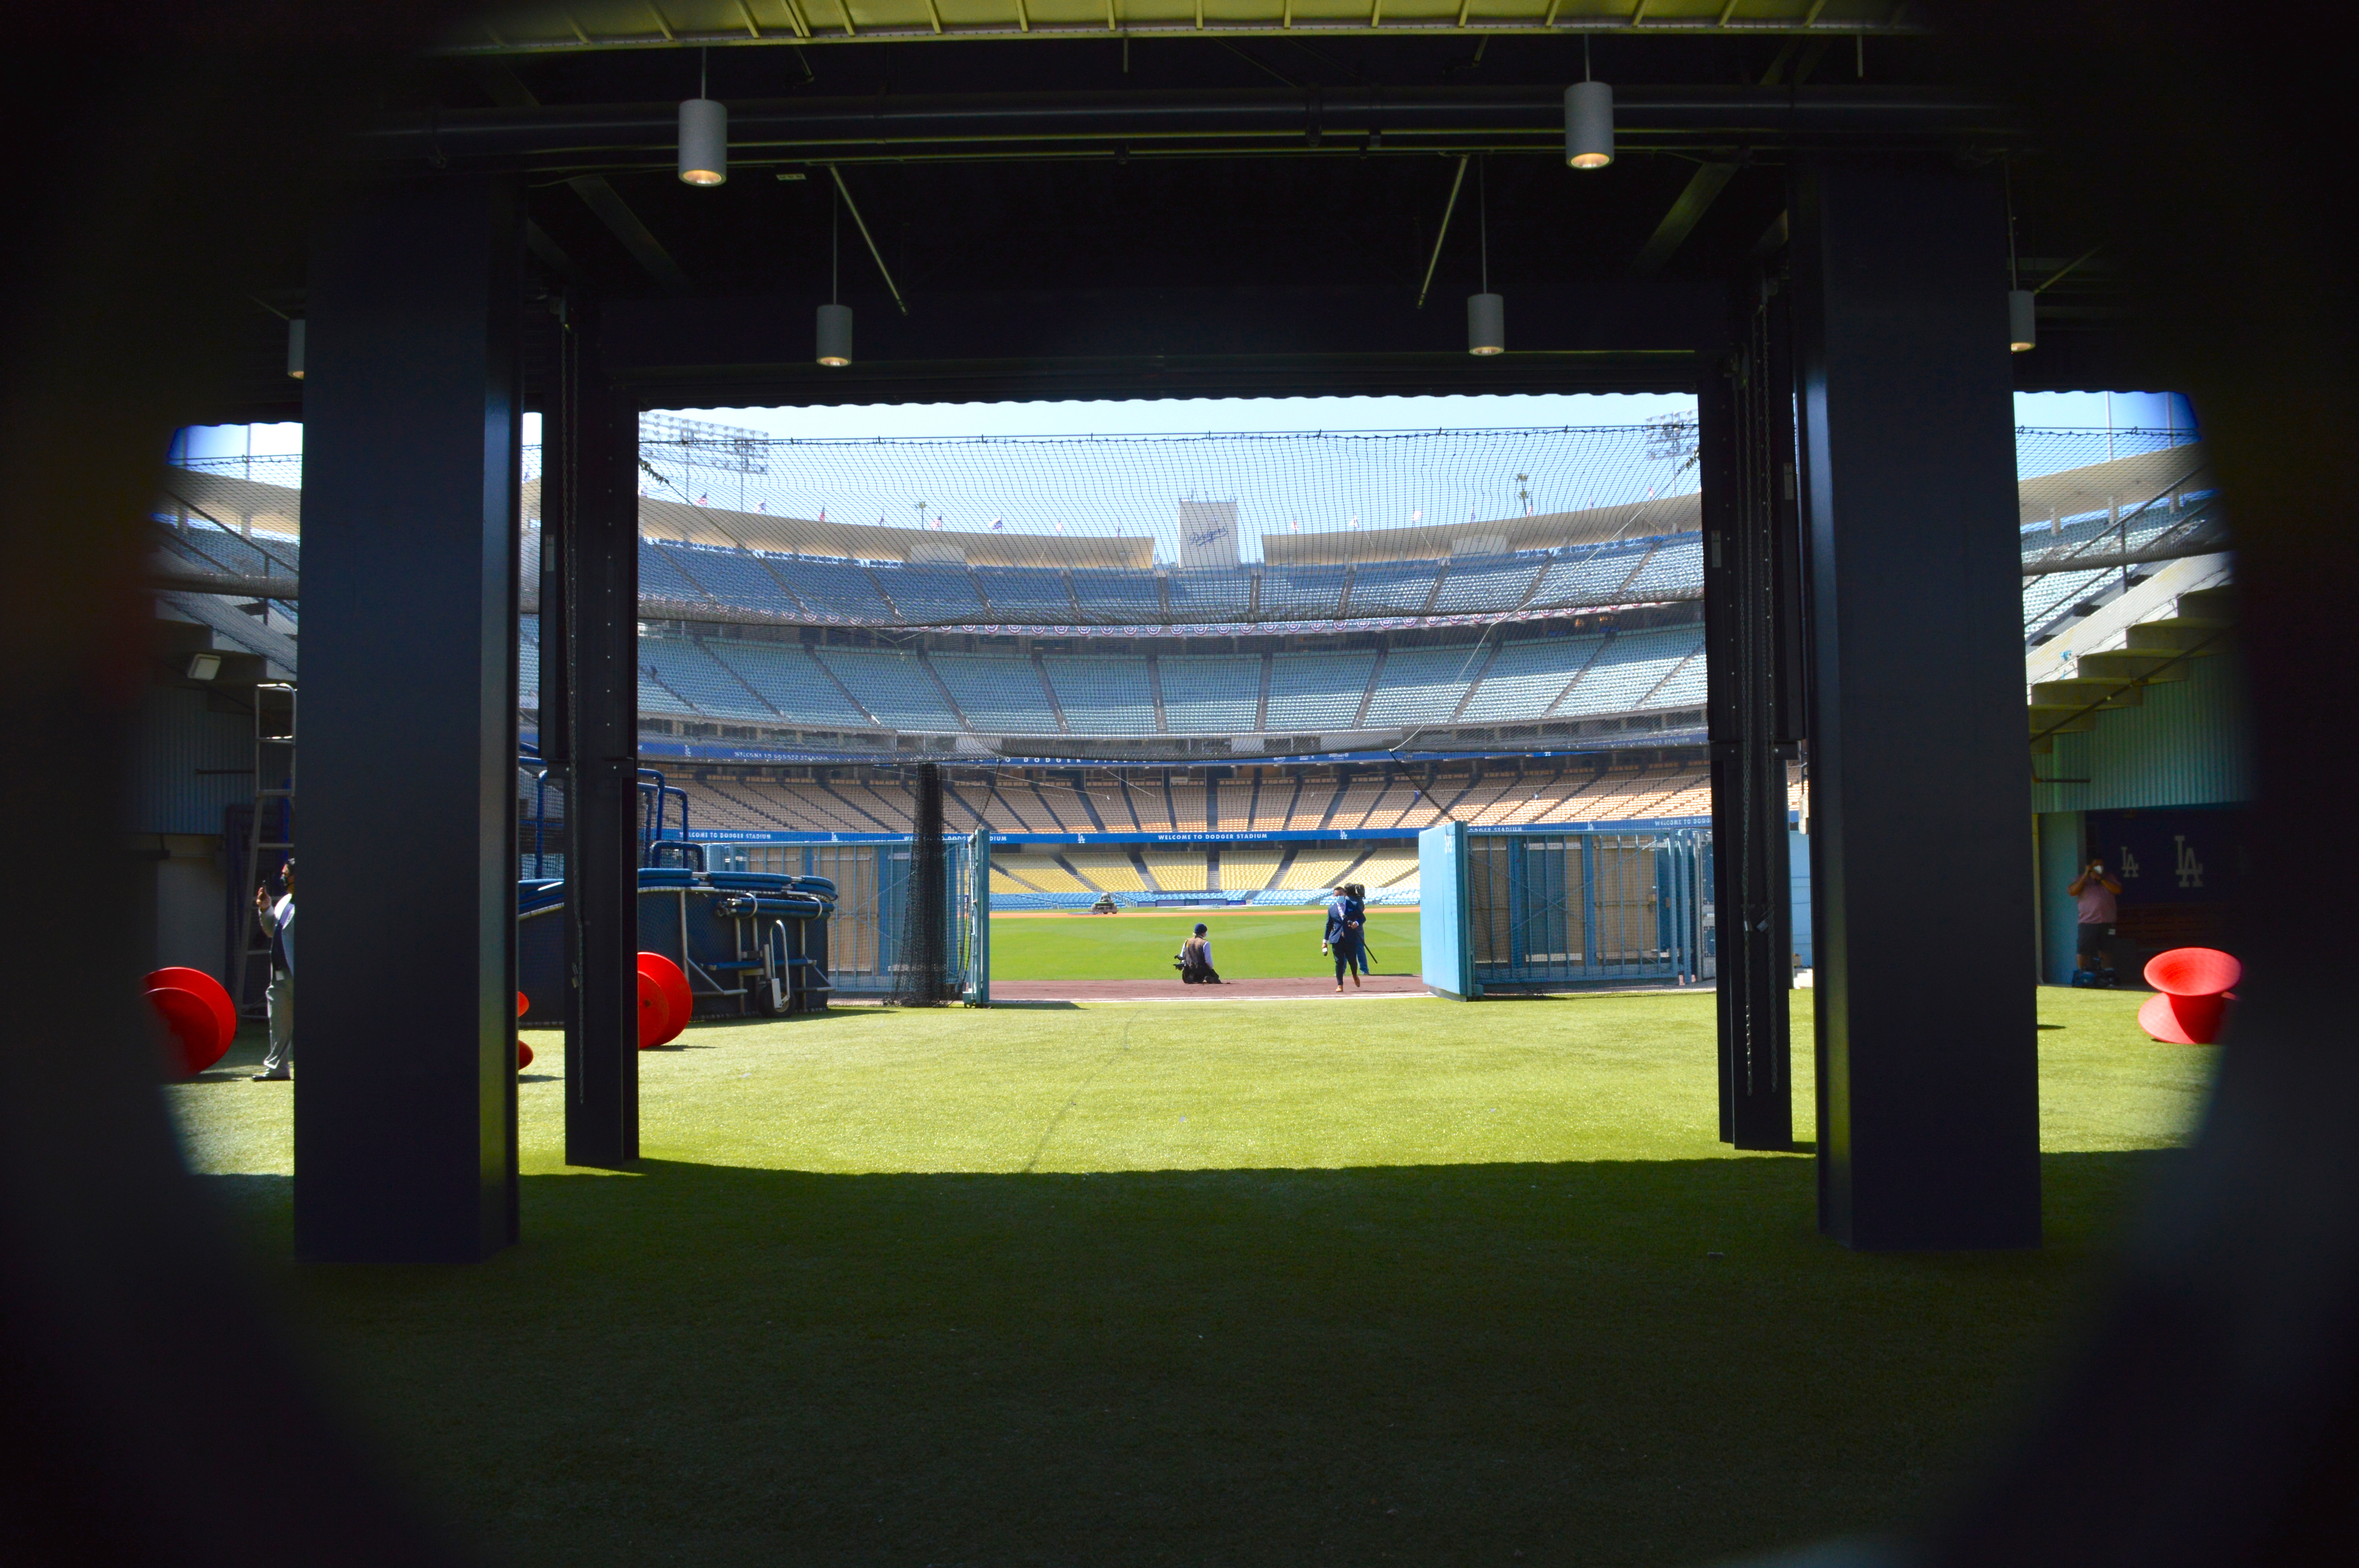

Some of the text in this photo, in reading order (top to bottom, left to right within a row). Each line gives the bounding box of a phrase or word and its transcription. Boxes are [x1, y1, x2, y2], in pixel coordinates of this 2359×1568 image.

[1189, 526, 1228, 546] Dodgers
[1078, 833, 1085, 843] LA
[1340, 829, 1347, 839] LA
[2121, 846, 2139, 877] LA
[2175, 835, 2203, 887] LA
